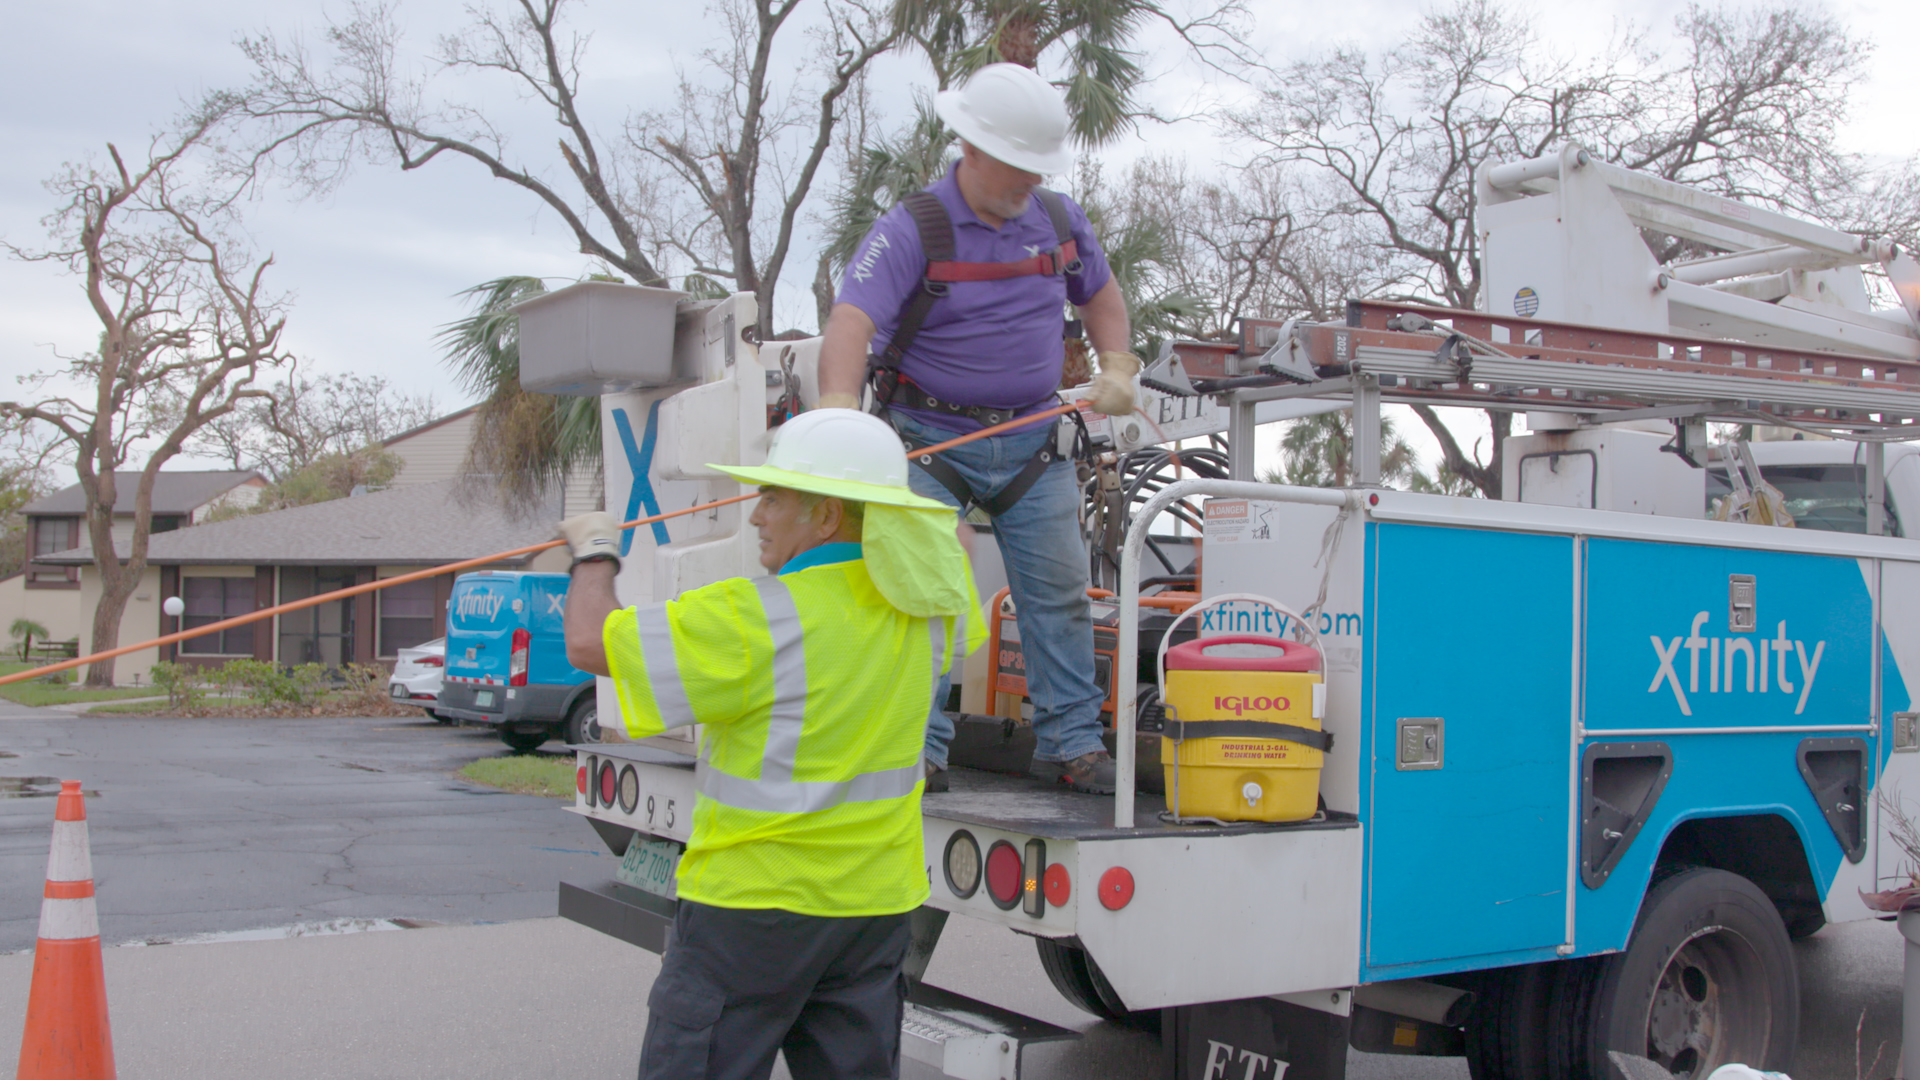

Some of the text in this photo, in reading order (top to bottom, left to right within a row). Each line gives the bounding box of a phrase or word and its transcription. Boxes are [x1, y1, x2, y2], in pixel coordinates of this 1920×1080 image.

[852, 232, 890, 283] xfinity
[1216, 505, 1245, 515] DANGER
[456, 587, 504, 623] xfinity
[1000, 650, 1026, 670] GP3
[1648, 611, 1826, 716] xfinity
[1215, 696, 1290, 716] IGLOO
[647, 795, 655, 824] 9
[666, 799, 675, 829] 5
[623, 845, 671, 884] GCP 700
